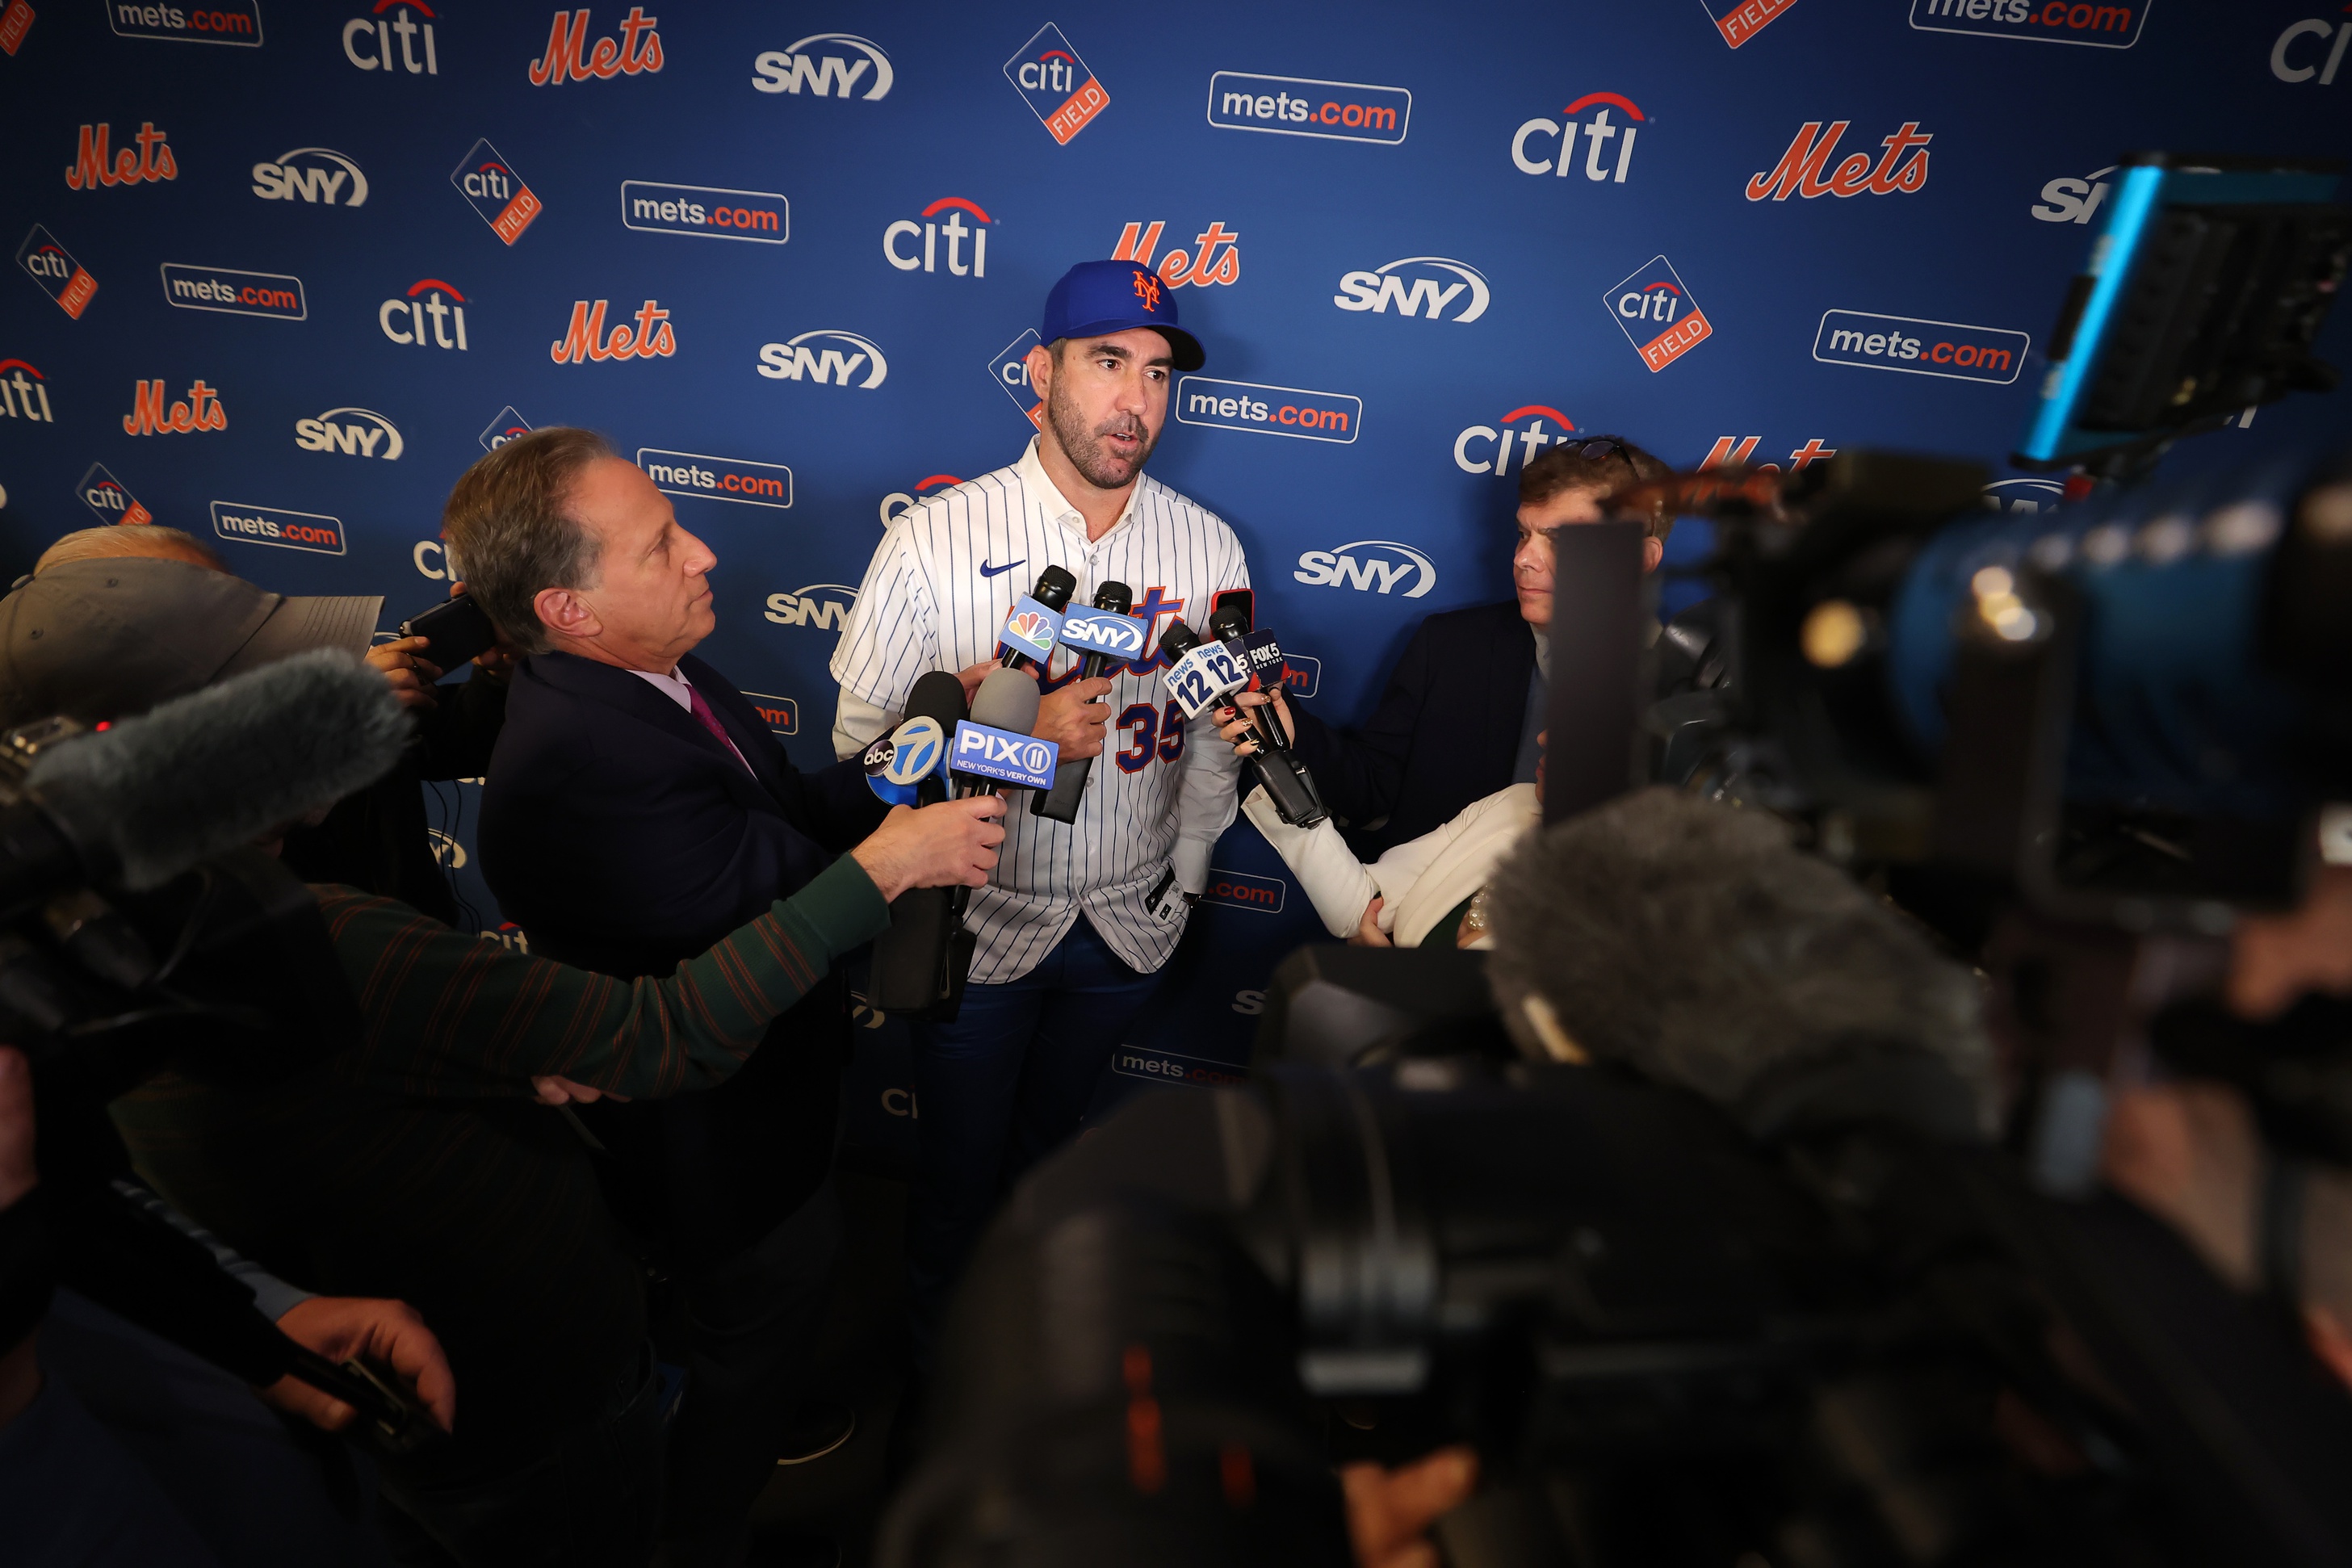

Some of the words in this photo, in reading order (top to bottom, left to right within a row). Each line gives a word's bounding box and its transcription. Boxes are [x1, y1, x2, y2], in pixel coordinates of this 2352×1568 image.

[119, 3, 252, 33] mets.com
[1726, 0, 1784, 40] FIEL
[343, 9, 437, 74] citi
[529, 7, 664, 86] Mets
[2270, 19, 2352, 85] ci
[753, 52, 870, 98] SNY
[1019, 57, 1072, 93] citi
[1052, 87, 1101, 137] FIELD
[1222, 92, 1396, 130] mets.com
[65, 122, 178, 190] Mets
[1511, 109, 1637, 182] citi
[1746, 121, 1933, 201] Mets
[253, 163, 347, 205] SNY
[463, 169, 509, 200] citi
[497, 195, 535, 238] FIELD
[634, 199, 778, 231] mets.com
[883, 212, 986, 277] citi
[1111, 221, 1240, 289] Mets
[27, 251, 69, 279] citi
[62, 275, 92, 313] FIELD
[174, 279, 296, 308] mets.com
[1334, 271, 1467, 319] SNY
[1618, 289, 1678, 322] citi
[379, 292, 467, 350] citi
[551, 300, 676, 364] Mets
[1647, 319, 1703, 365] FIELD
[1830, 330, 2010, 370] mets.com
[757, 343, 866, 388] SNY
[1002, 362, 1029, 386] ci
[0, 371, 53, 423] iti
[124, 379, 227, 435] Mets
[1190, 395, 1348, 431] mets.com
[296, 419, 384, 457] SNY
[1454, 420, 1567, 476] cit
[86, 487, 125, 511] citi
[648, 463, 783, 497] mets.com
[222, 514, 337, 545] mets.com
[413, 540, 457, 581] ci
[1294, 551, 1415, 593] SNY
[1061, 618, 1132, 648] SNY
[1197, 644, 1224, 659] news
[1168, 658, 1194, 686] news
[1206, 655, 1243, 685] 12
[1256, 662, 1268, 670] NEW
[1268, 656, 1284, 665] YORK
[1176, 670, 1214, 711] 12
[864, 748, 894, 765] abc
[889, 720, 940, 781] 7
[959, 728, 1024, 766] PIX
[1116, 702, 1185, 774] 35
[957, 759, 976, 769] NEW
[976, 763, 1005, 777] YORK'S
[1006, 769, 1027, 782] VERY
[1027, 774, 1046, 786] OWN
[881, 1088, 918, 1120] ci
